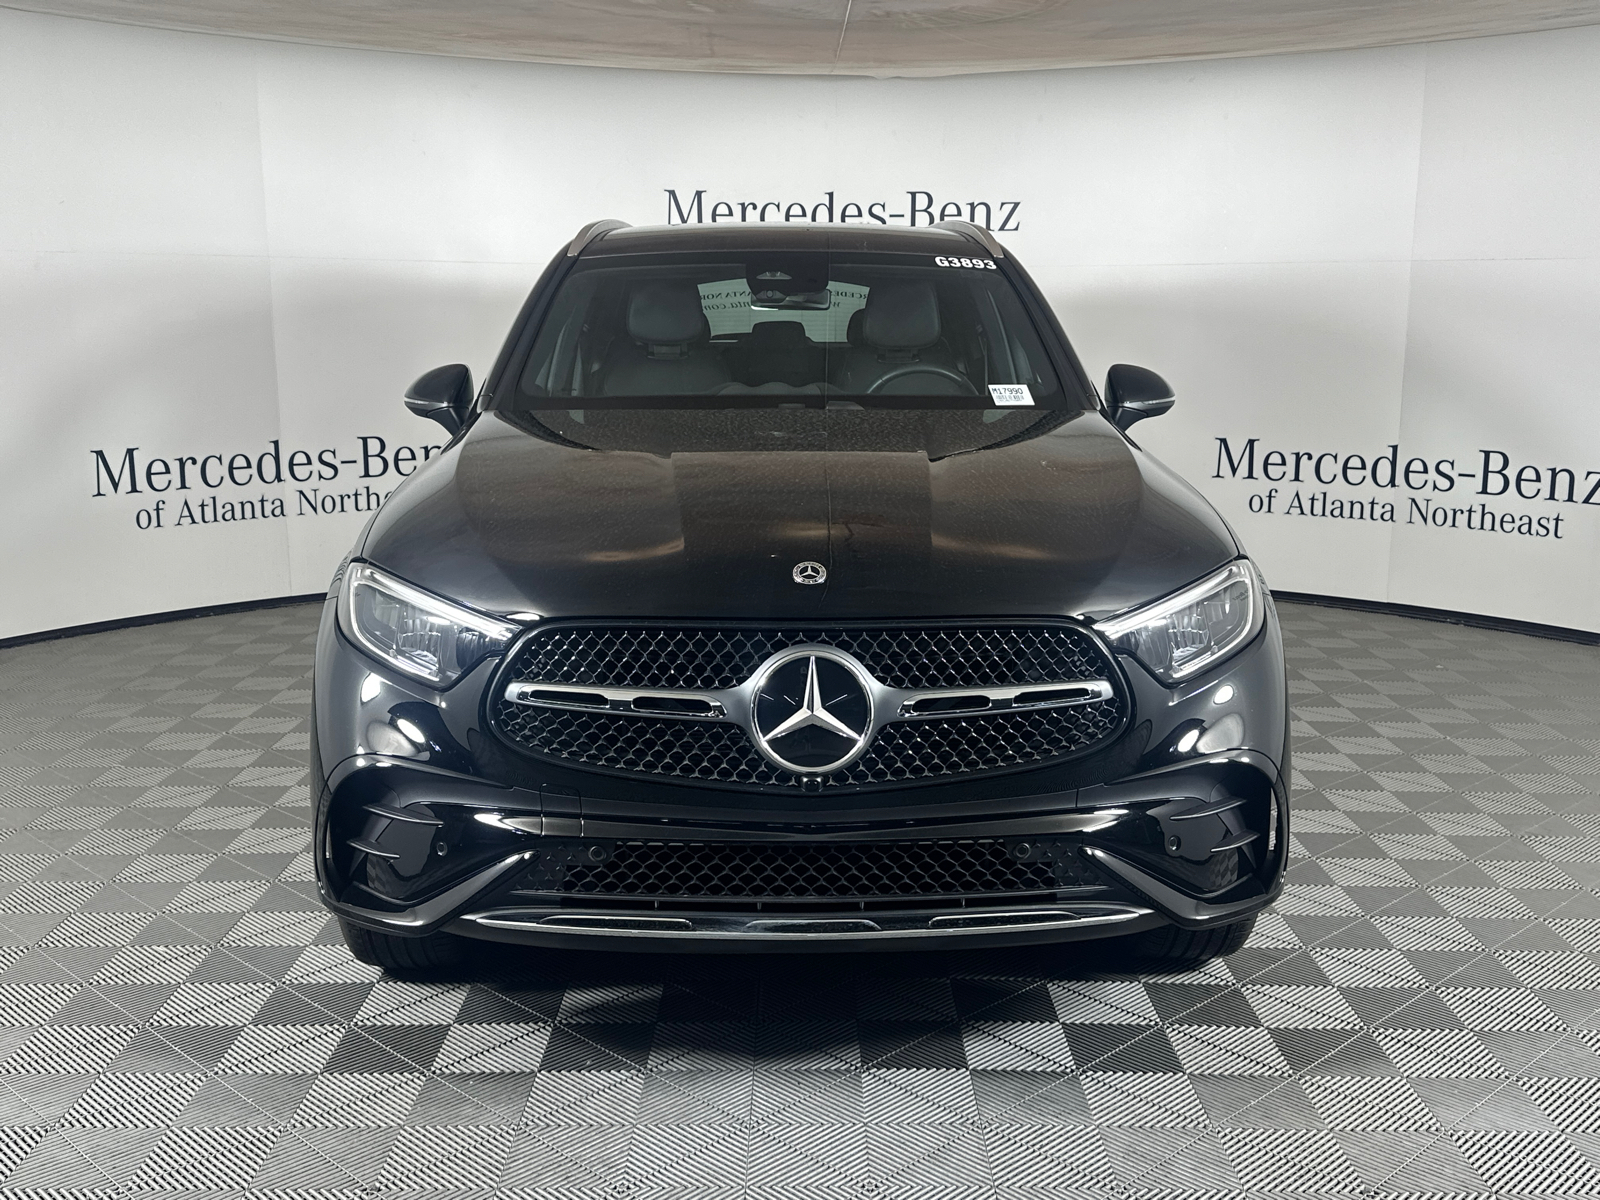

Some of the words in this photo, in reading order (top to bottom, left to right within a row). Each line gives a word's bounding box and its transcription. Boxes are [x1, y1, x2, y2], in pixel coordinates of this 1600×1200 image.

[934, 256, 997, 270] G3893
[991, 387, 1024, 395] M17990
[90, 436, 442, 498] Mercedes-Be
[1212, 437, 1600, 506] Mercedes-Benz
[135, 500, 166, 530] of
[174, 494, 287, 527] Atlanta
[296, 485, 393, 517] North
[1248, 488, 1278, 514] of
[1284, 490, 1396, 523] Atlanta
[1406, 497, 1565, 539] Northeast
